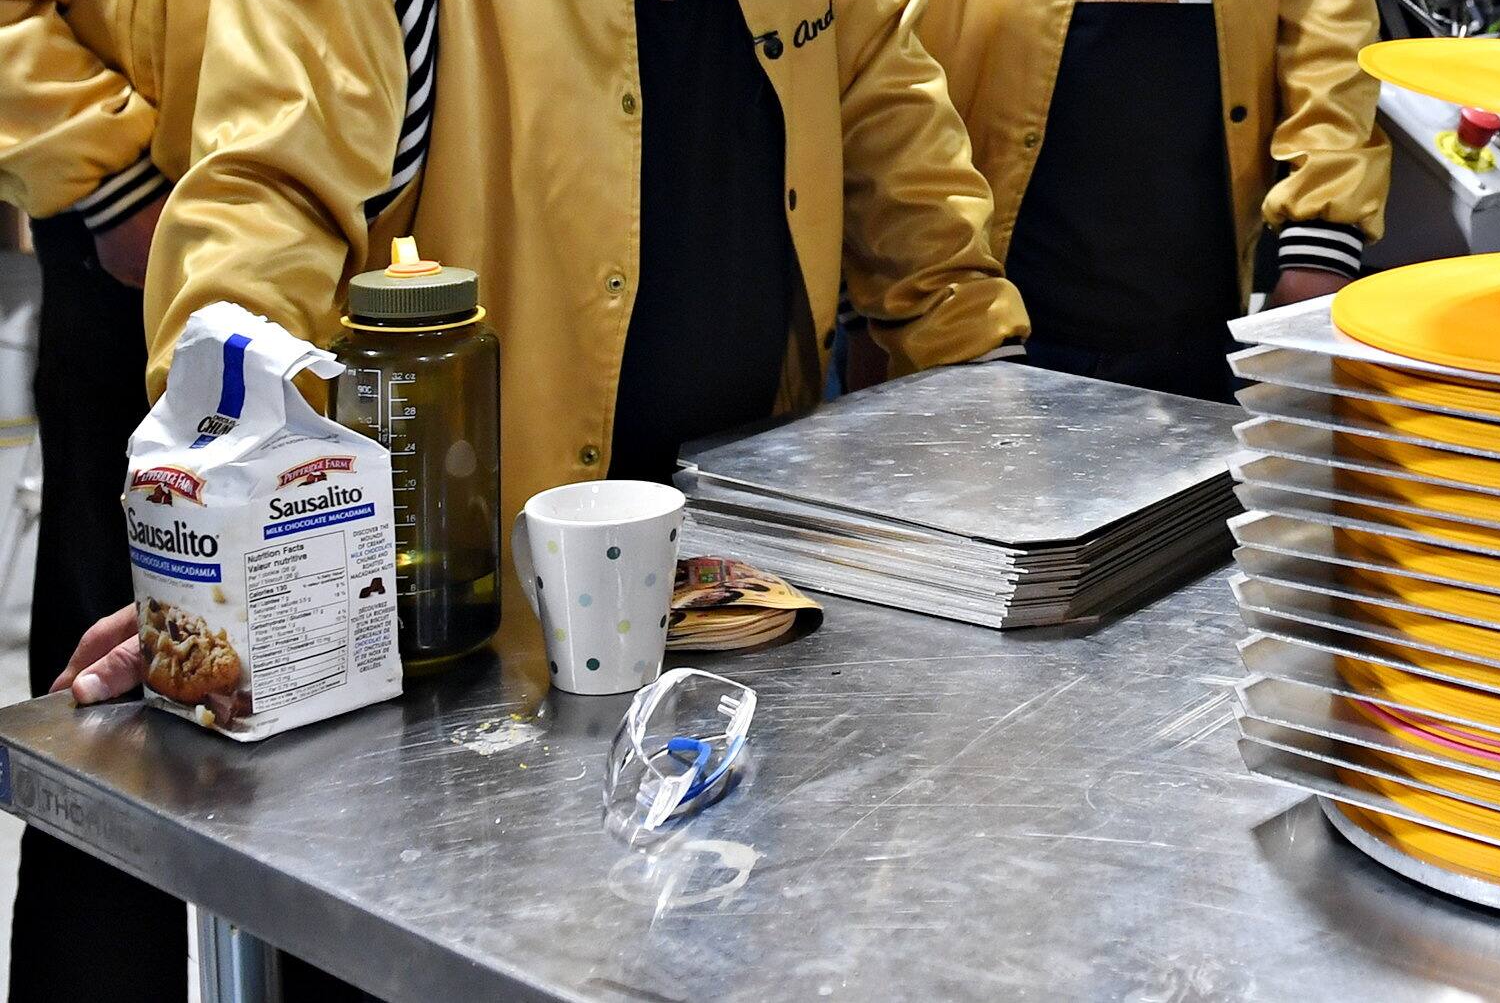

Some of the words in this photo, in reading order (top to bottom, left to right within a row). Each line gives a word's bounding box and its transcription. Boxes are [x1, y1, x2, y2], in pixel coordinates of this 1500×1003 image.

[404, 407, 416, 415] 28
[325, 458, 349, 470] FARM
[269, 486, 363, 520] Sausalito
[265, 524, 283, 536] MILK
[284, 516, 327, 532] CHOCOLATE
[328, 506, 372, 522] MACADAMIA
[128, 507, 219, 558] Sausalito
[247, 549, 281, 564] Nutrition
[283, 543, 305, 554] Facts
[364, 542, 393, 555] CHOCOLATE
[171, 563, 217, 578] MACADAMIA
[248, 560, 271, 573] Valeur
[273, 552, 308, 567] nutritive
[249, 588, 274, 599] Calories
